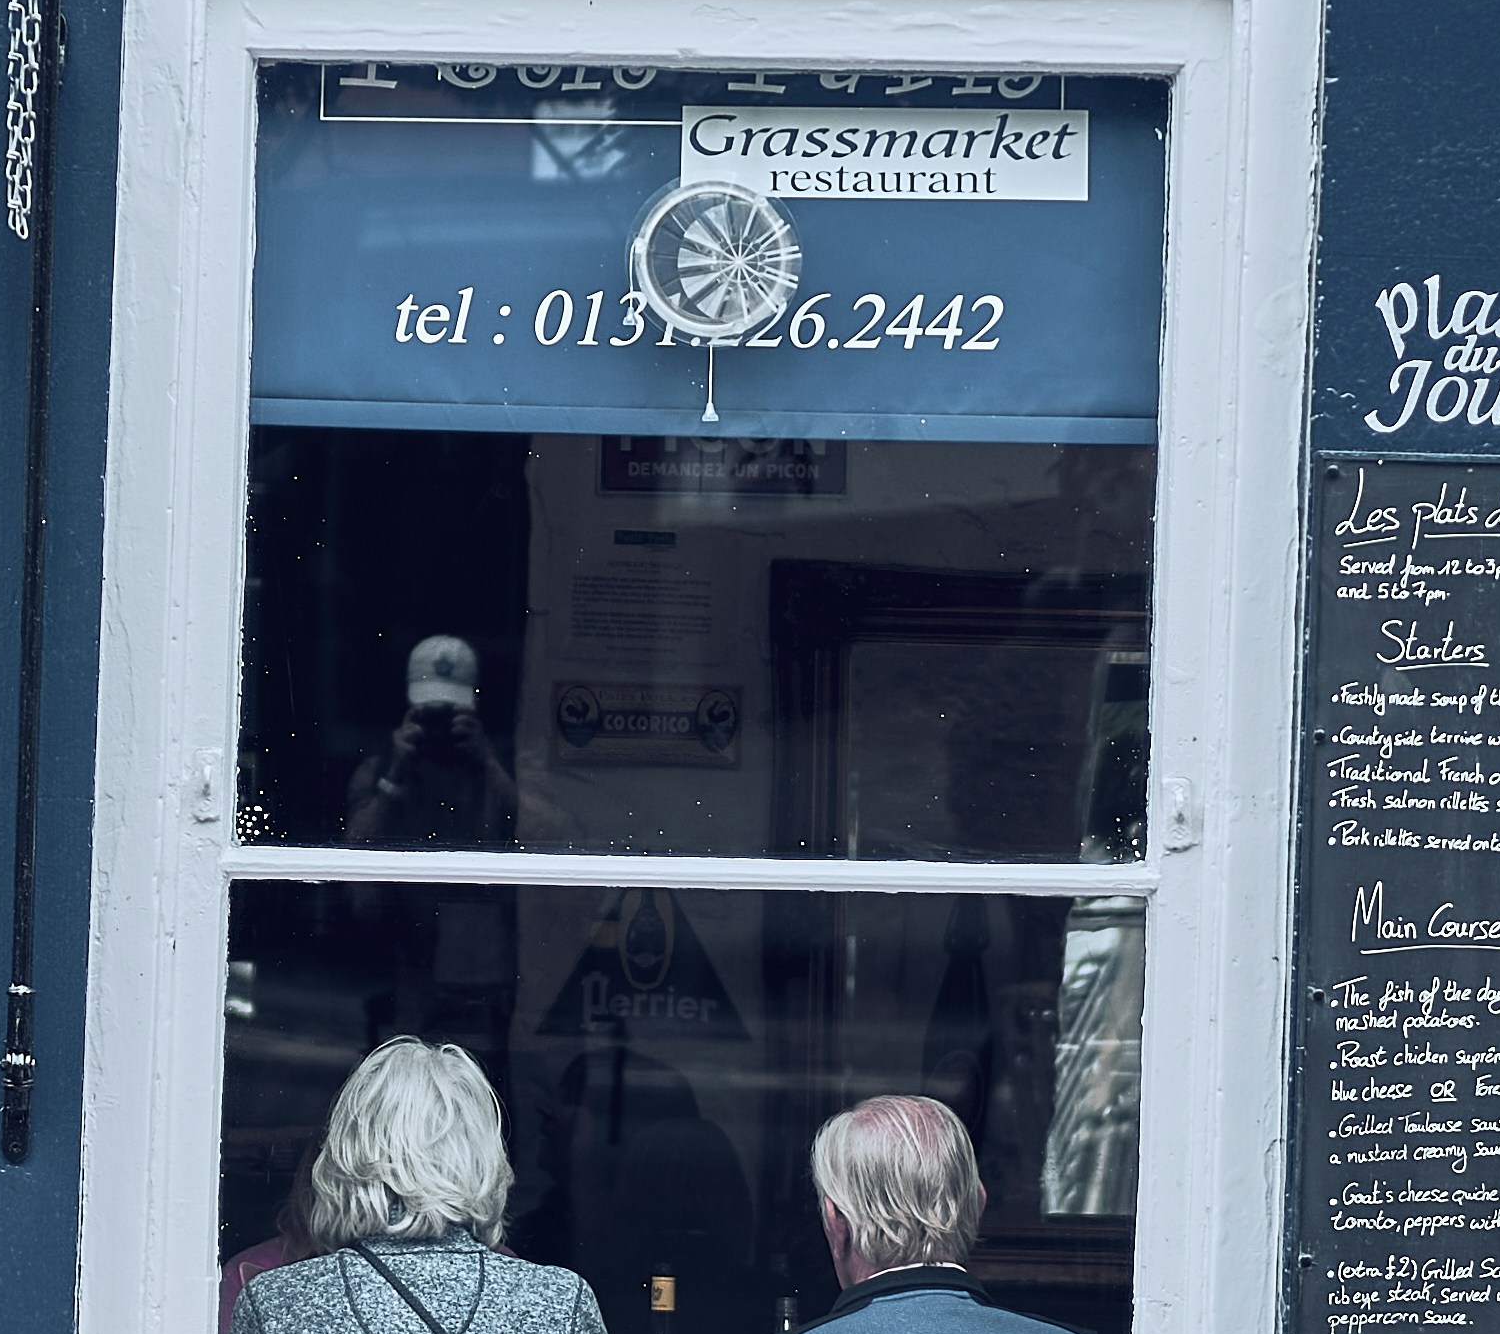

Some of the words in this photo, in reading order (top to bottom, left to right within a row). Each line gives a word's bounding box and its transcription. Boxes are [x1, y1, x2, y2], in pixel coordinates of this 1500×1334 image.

[687, 110, 1079, 163] Grassmarket
[768, 162, 1000, 196] restaurant
[395, 285, 475, 346] tel
[765, 462, 820, 480] PICON
[1335, 467, 1401, 537] Les
[1411, 482, 1479, 549] plats
[1340, 554, 1396, 575] Served
[1400, 555, 1435, 587] from
[1337, 583, 1372, 600] and
[1376, 619, 1485, 664] Starters
[1340, 682, 1386, 715] Freshly
[1389, 687, 1425, 707] made
[604, 714, 690, 734] COCORICO
[1339, 725, 1423, 758] Countryside
[1430, 725, 1483, 746] terrine
[1327, 754, 1430, 783] Traditional
[1438, 756, 1484, 783] French
[1332, 785, 1376, 809] Fresh
[1383, 789, 1435, 810] salmon
[1332, 819, 1370, 847] Pork
[1351, 880, 1417, 943] Main
[580, 970, 719, 1032] Perrier
[1332, 975, 1370, 1009] The
[1379, 980, 1414, 1011] fish
[1443, 980, 1472, 1002] the
[1335, 1010, 1397, 1032] mashed
[1336, 1040, 1387, 1068] Roast
[1393, 1042, 1448, 1066] chicken
[1331, 1080, 1358, 1102] blue
[1361, 1077, 1413, 1101] cheese
[1338, 1112, 1393, 1138] Grilled
[1398, 1111, 1462, 1134] Toulouse
[1347, 1143, 1407, 1164] mustard
[1413, 1147, 1467, 1174] creamy
[1342, 1179, 1394, 1205] Goat's
[1398, 1179, 1449, 1204] cheese
[1404, 1214, 1465, 1236] peppers
[1420, 1258, 1474, 1281] Grilled
